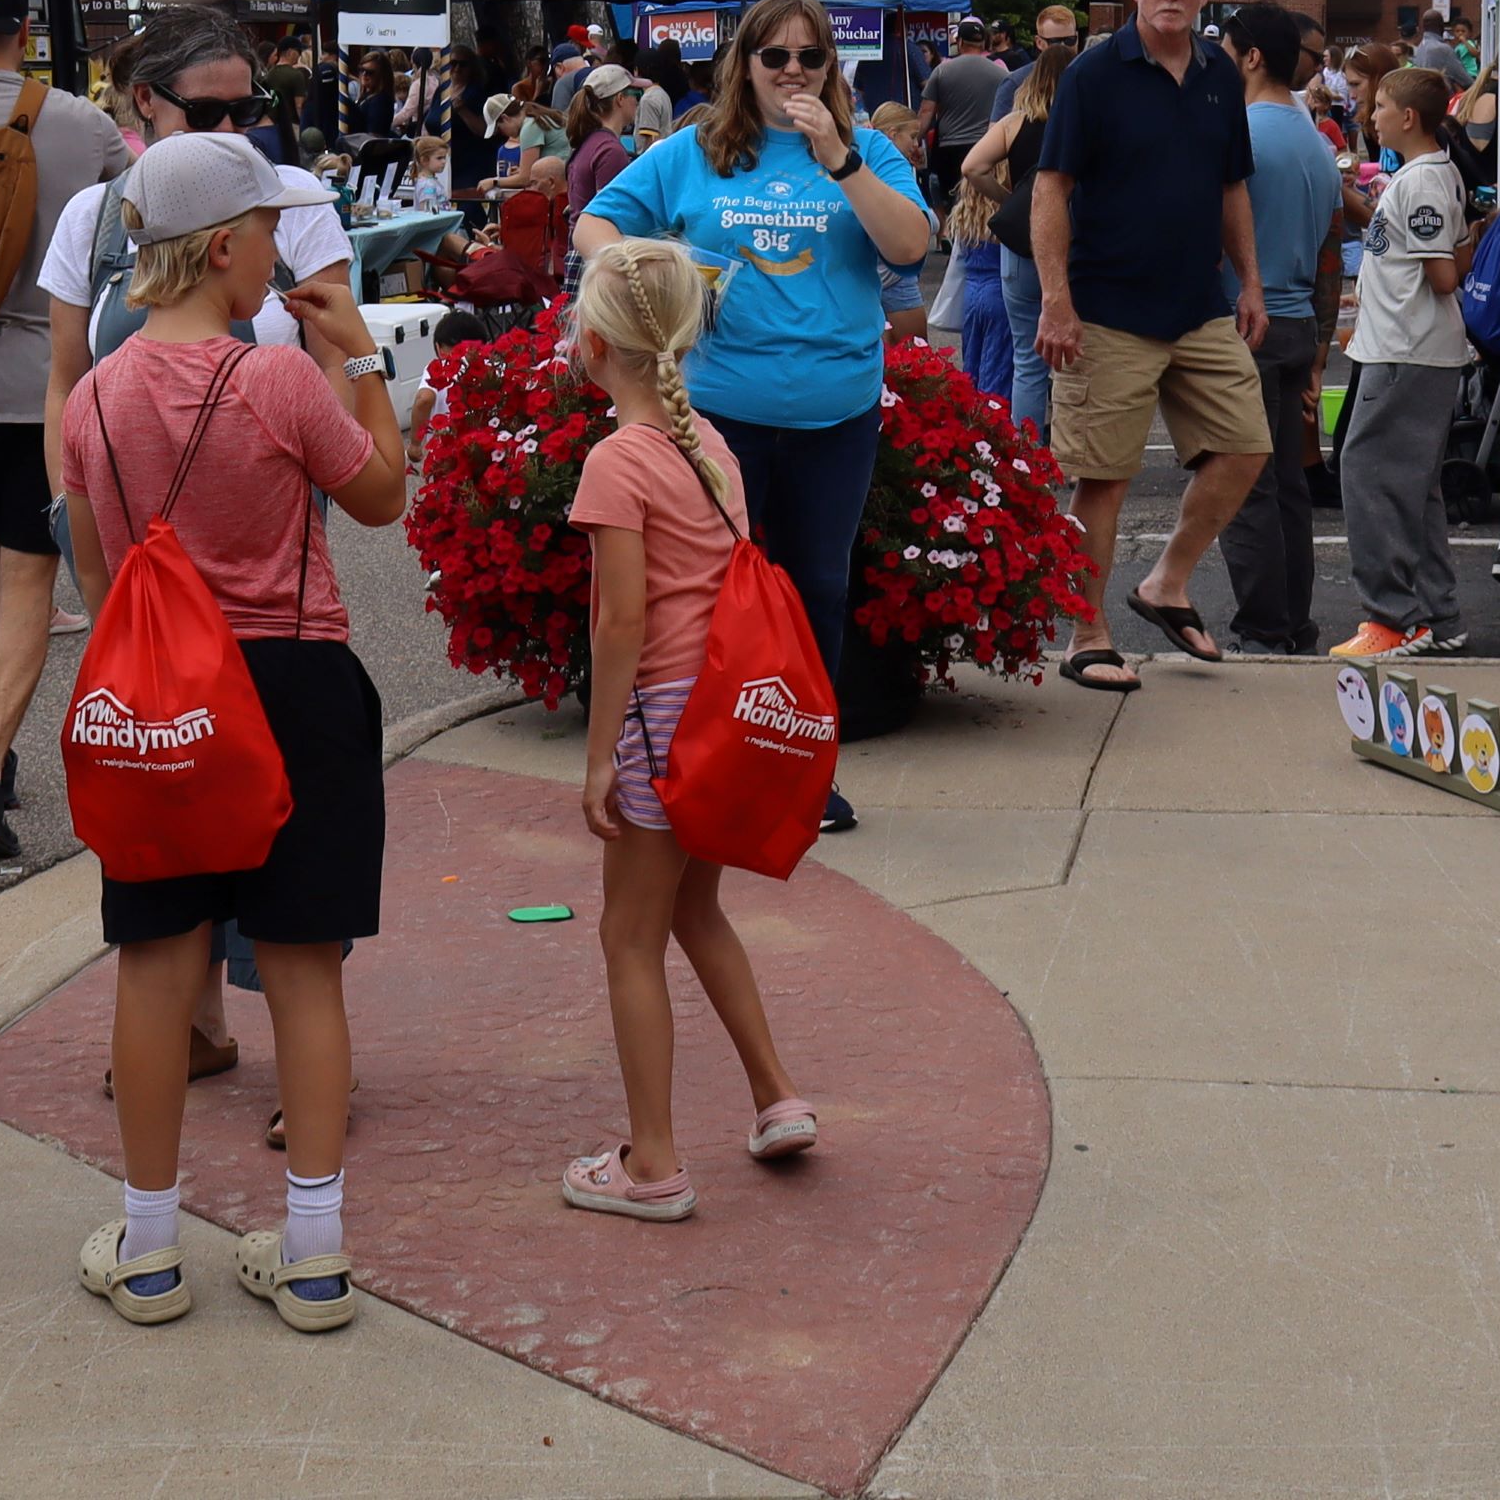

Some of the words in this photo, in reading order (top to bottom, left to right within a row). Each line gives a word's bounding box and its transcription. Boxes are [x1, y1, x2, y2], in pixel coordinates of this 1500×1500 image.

[828, 12, 853, 29] Amy
[909, 22, 930, 30] NGIE
[652, 25, 715, 45] CRAIG
[832, 26, 880, 40] obuchar
[908, 28, 948, 42] RAIG
[712, 196, 740, 209] The
[743, 196, 826, 212] Beginning
[828, 201, 844, 213] of
[721, 210, 829, 232] Something
[1425, 216, 1442, 227] FIELD
[753, 229, 790, 251] Big
[758, 684, 789, 712] Mr.
[87, 699, 128, 727] Mr.
[733, 687, 835, 742] Handyman
[71, 708, 214, 756] Handyman
[744, 735, 750, 743] a
[786, 746, 815, 760] company
[151, 758, 196, 773] company
